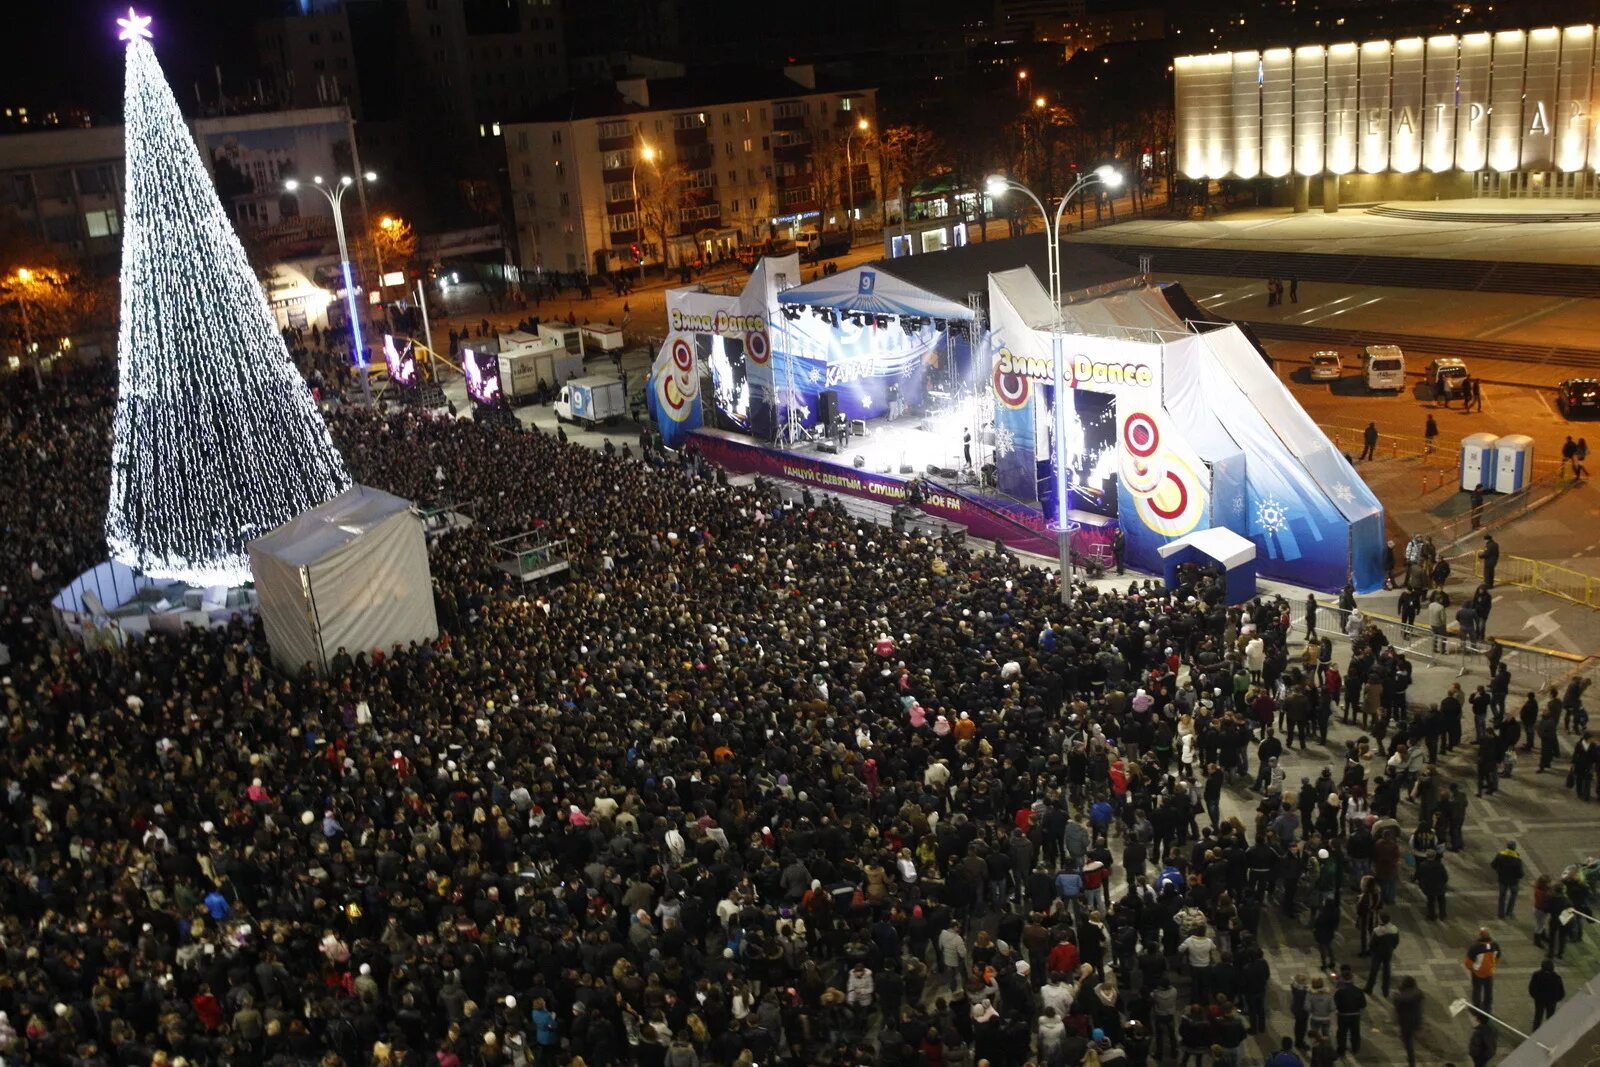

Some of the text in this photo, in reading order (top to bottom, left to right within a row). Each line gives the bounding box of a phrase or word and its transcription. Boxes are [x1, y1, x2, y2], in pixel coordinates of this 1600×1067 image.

[1336, 100, 1600, 136] ТЕАТР ДР
[862, 276, 871, 290] 9
[574, 391, 583, 409] 9
[823, 473, 861, 490] ДЕВЯТЫМ
[868, 482, 906, 499] СЛУШАЙ
